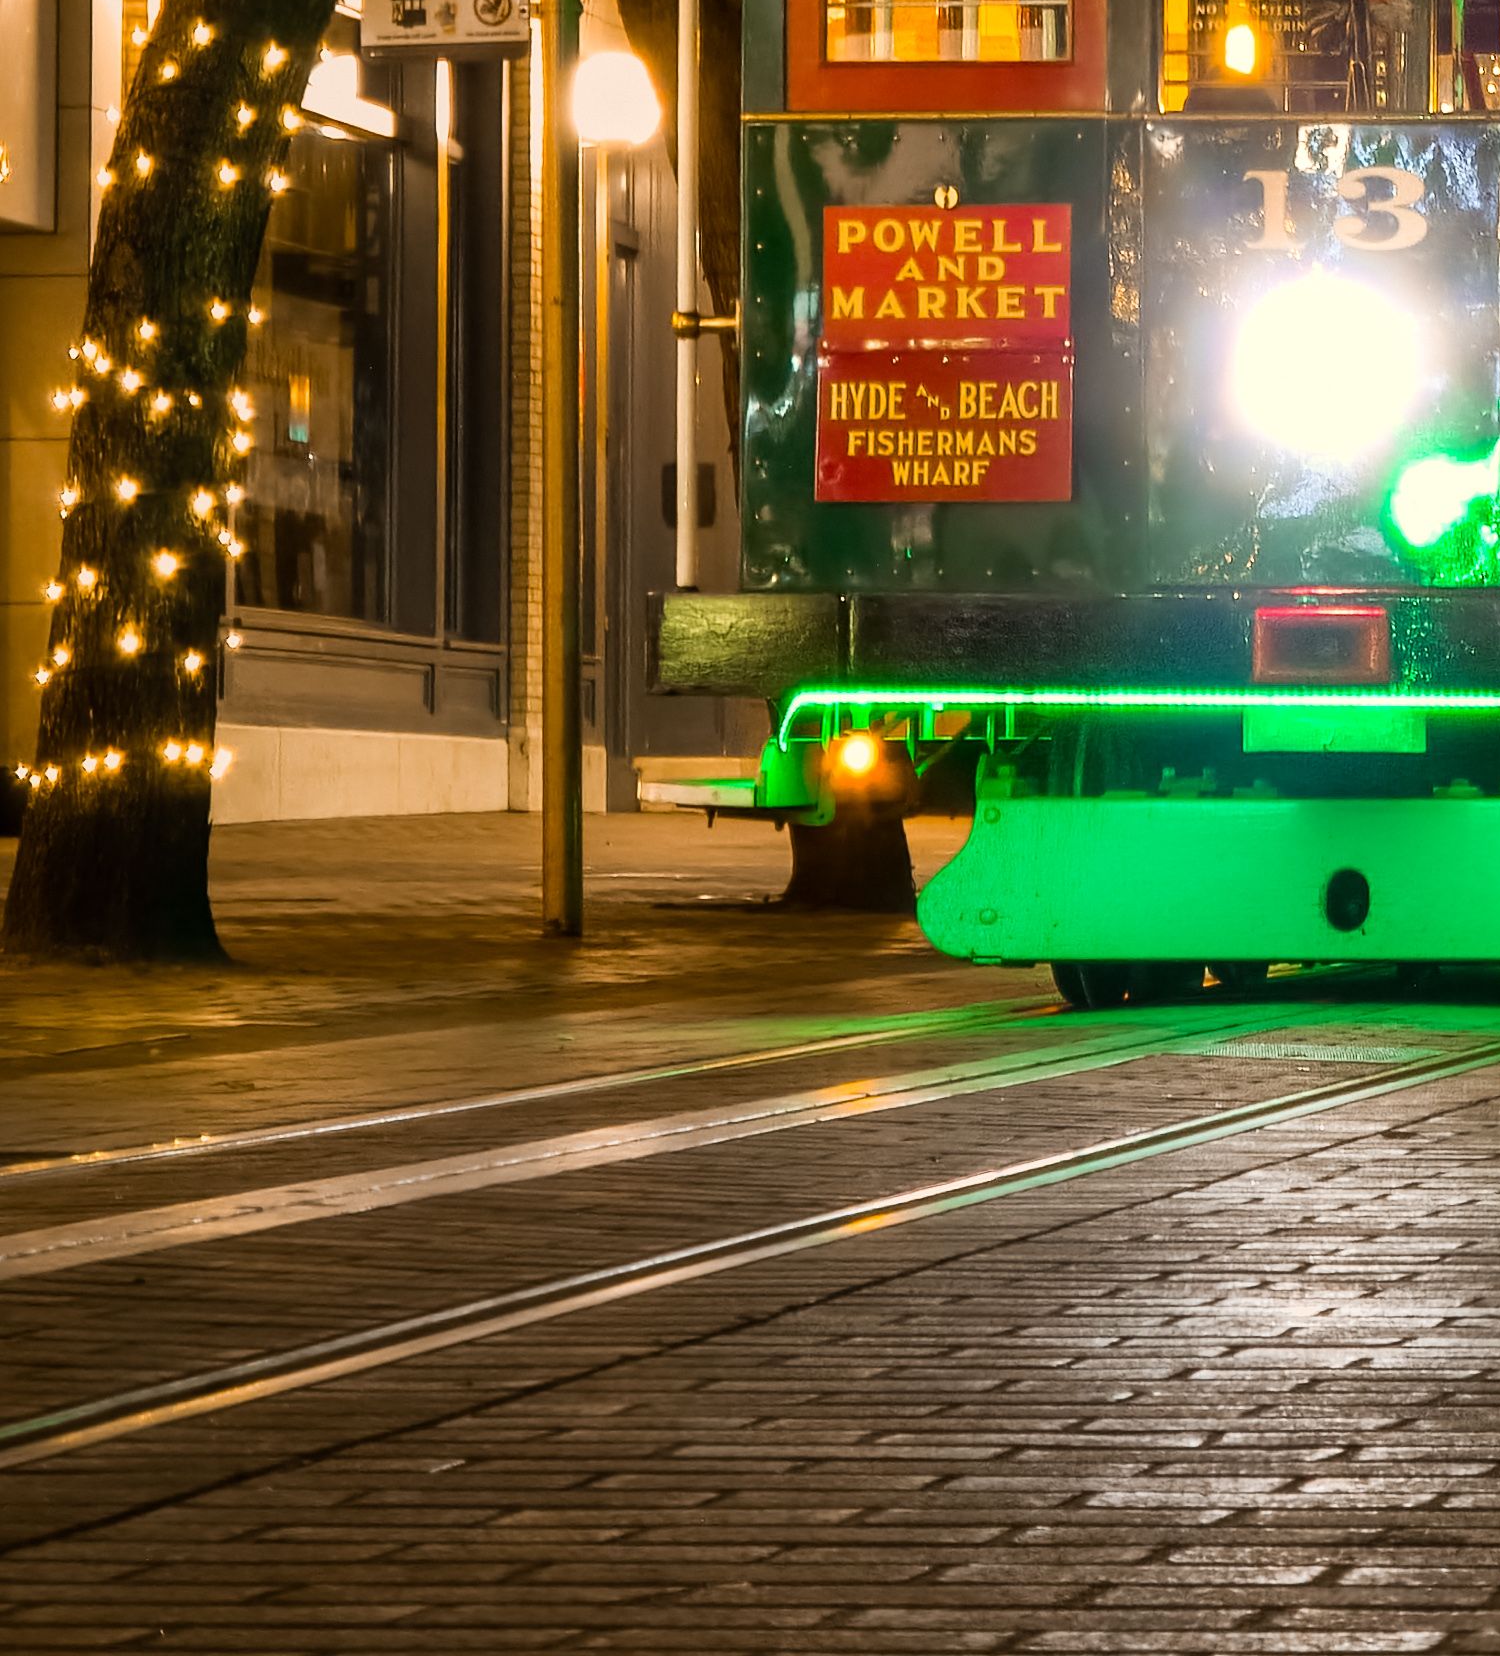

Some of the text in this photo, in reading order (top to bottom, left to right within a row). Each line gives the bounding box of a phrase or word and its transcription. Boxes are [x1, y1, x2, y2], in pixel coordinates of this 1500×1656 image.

[1196, 4, 1217, 15] NO
[1243, 166, 1428, 251] 13
[837, 219, 1063, 254] POWELL
[896, 255, 1007, 282] AND
[831, 286, 1066, 320] MARKET
[830, 380, 1059, 421] HYDE AND BEACH
[847, 429, 1037, 457] FISHERMANS
[891, 461, 991, 487] WHARF
